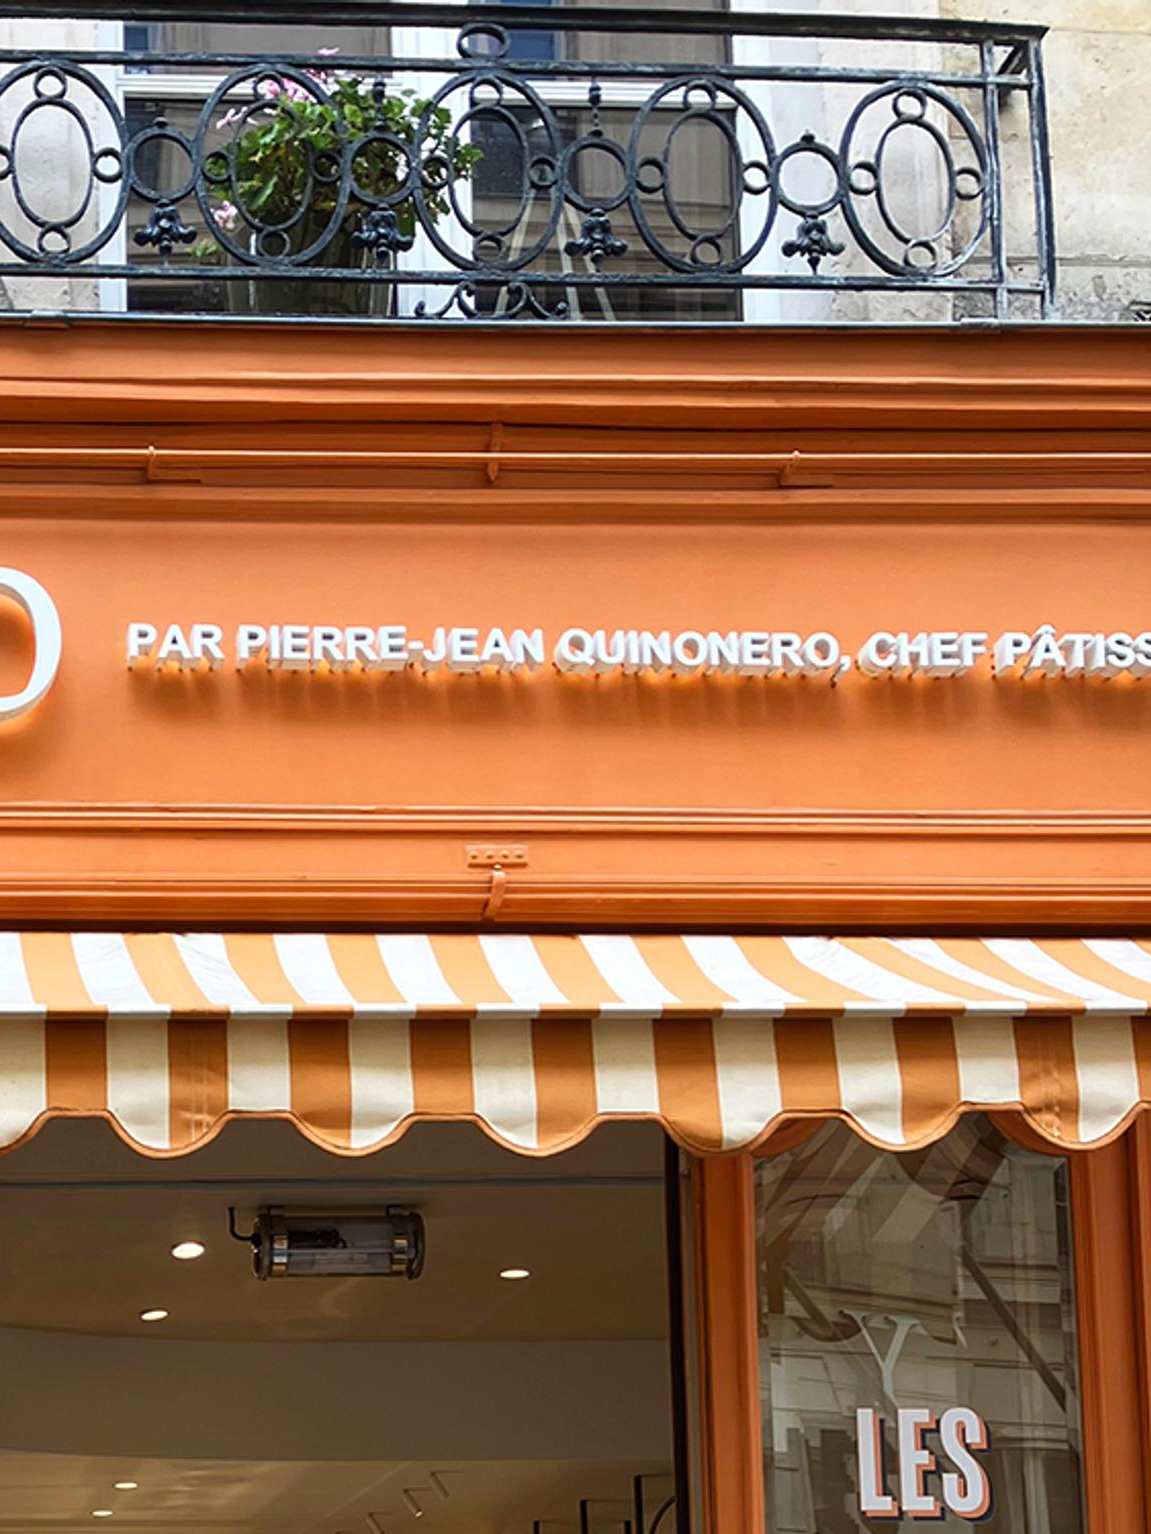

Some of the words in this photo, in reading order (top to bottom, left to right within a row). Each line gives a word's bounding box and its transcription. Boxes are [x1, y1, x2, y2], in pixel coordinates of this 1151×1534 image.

[127, 622, 225, 667] PAR
[236, 624, 544, 669] PIERRE-JEAN
[556, 628, 850, 674] QUINONERO,
[859, 631, 987, 673] CHEF
[855, 1406, 992, 1521] LES
